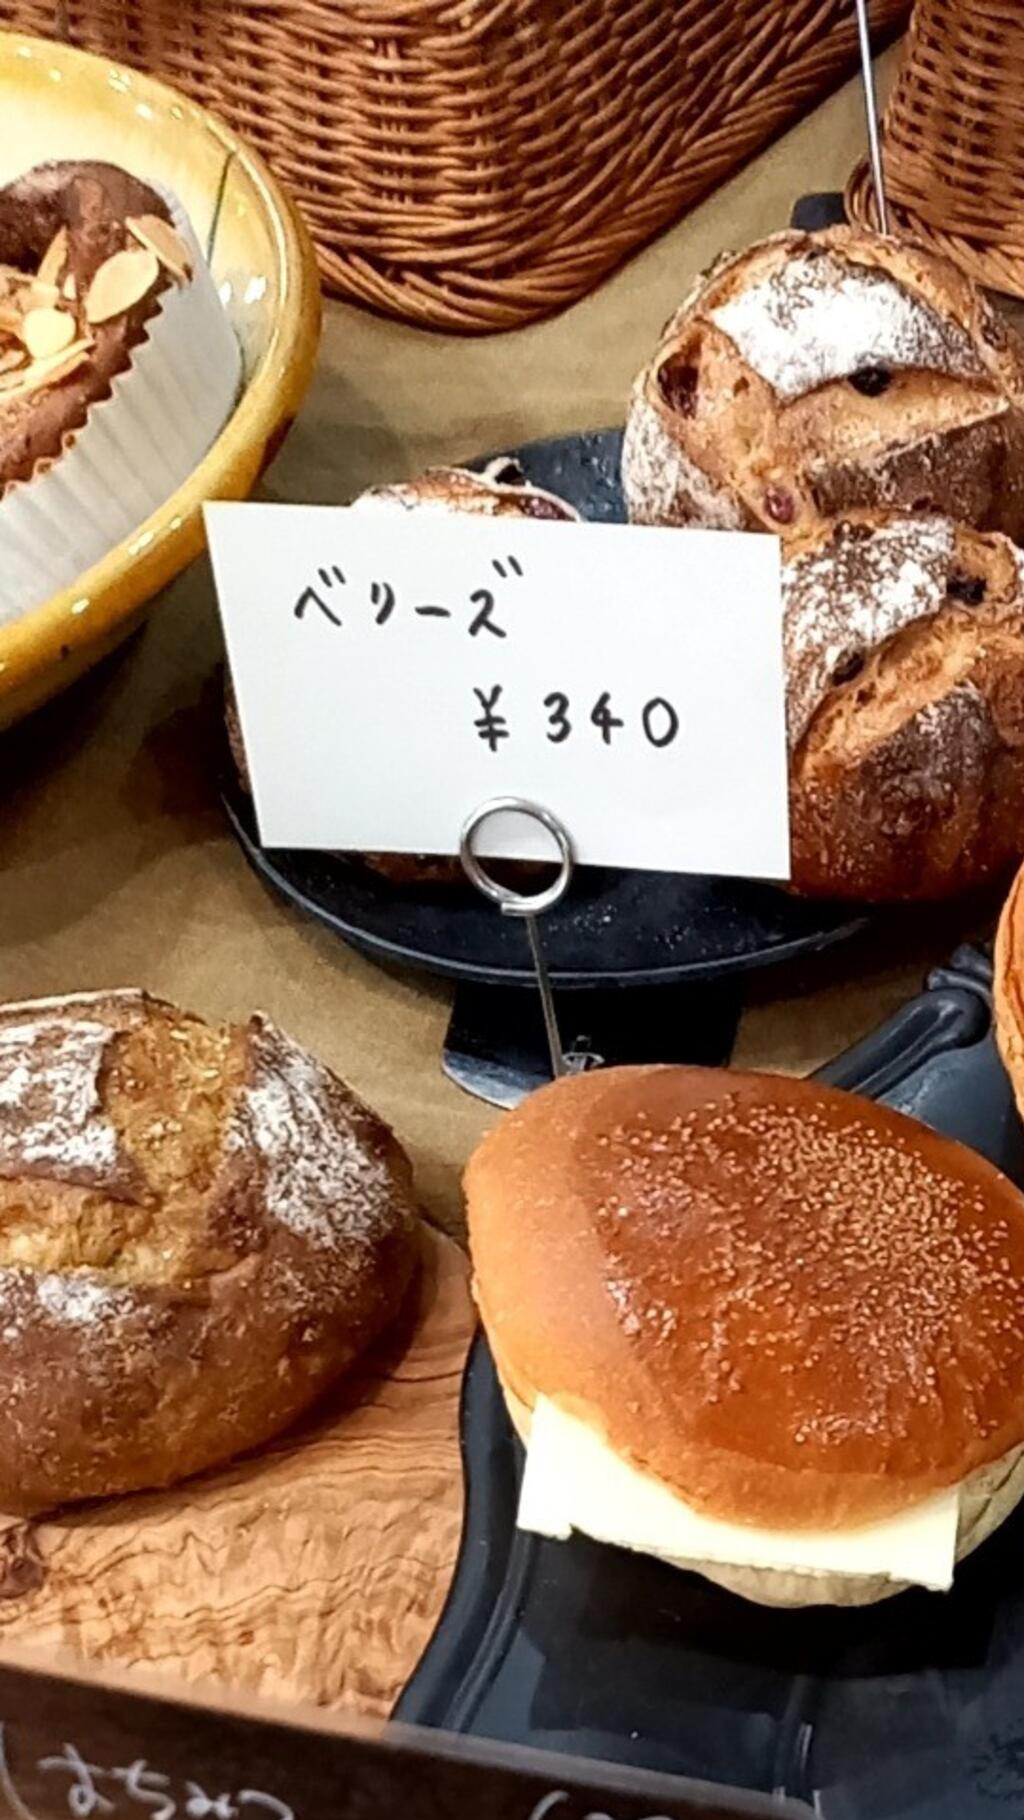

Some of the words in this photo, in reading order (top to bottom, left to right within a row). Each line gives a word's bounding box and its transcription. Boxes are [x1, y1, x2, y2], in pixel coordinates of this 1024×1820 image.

[293, 554, 525, 639] ベリーズ
[472, 684, 680, 753] ¥340
